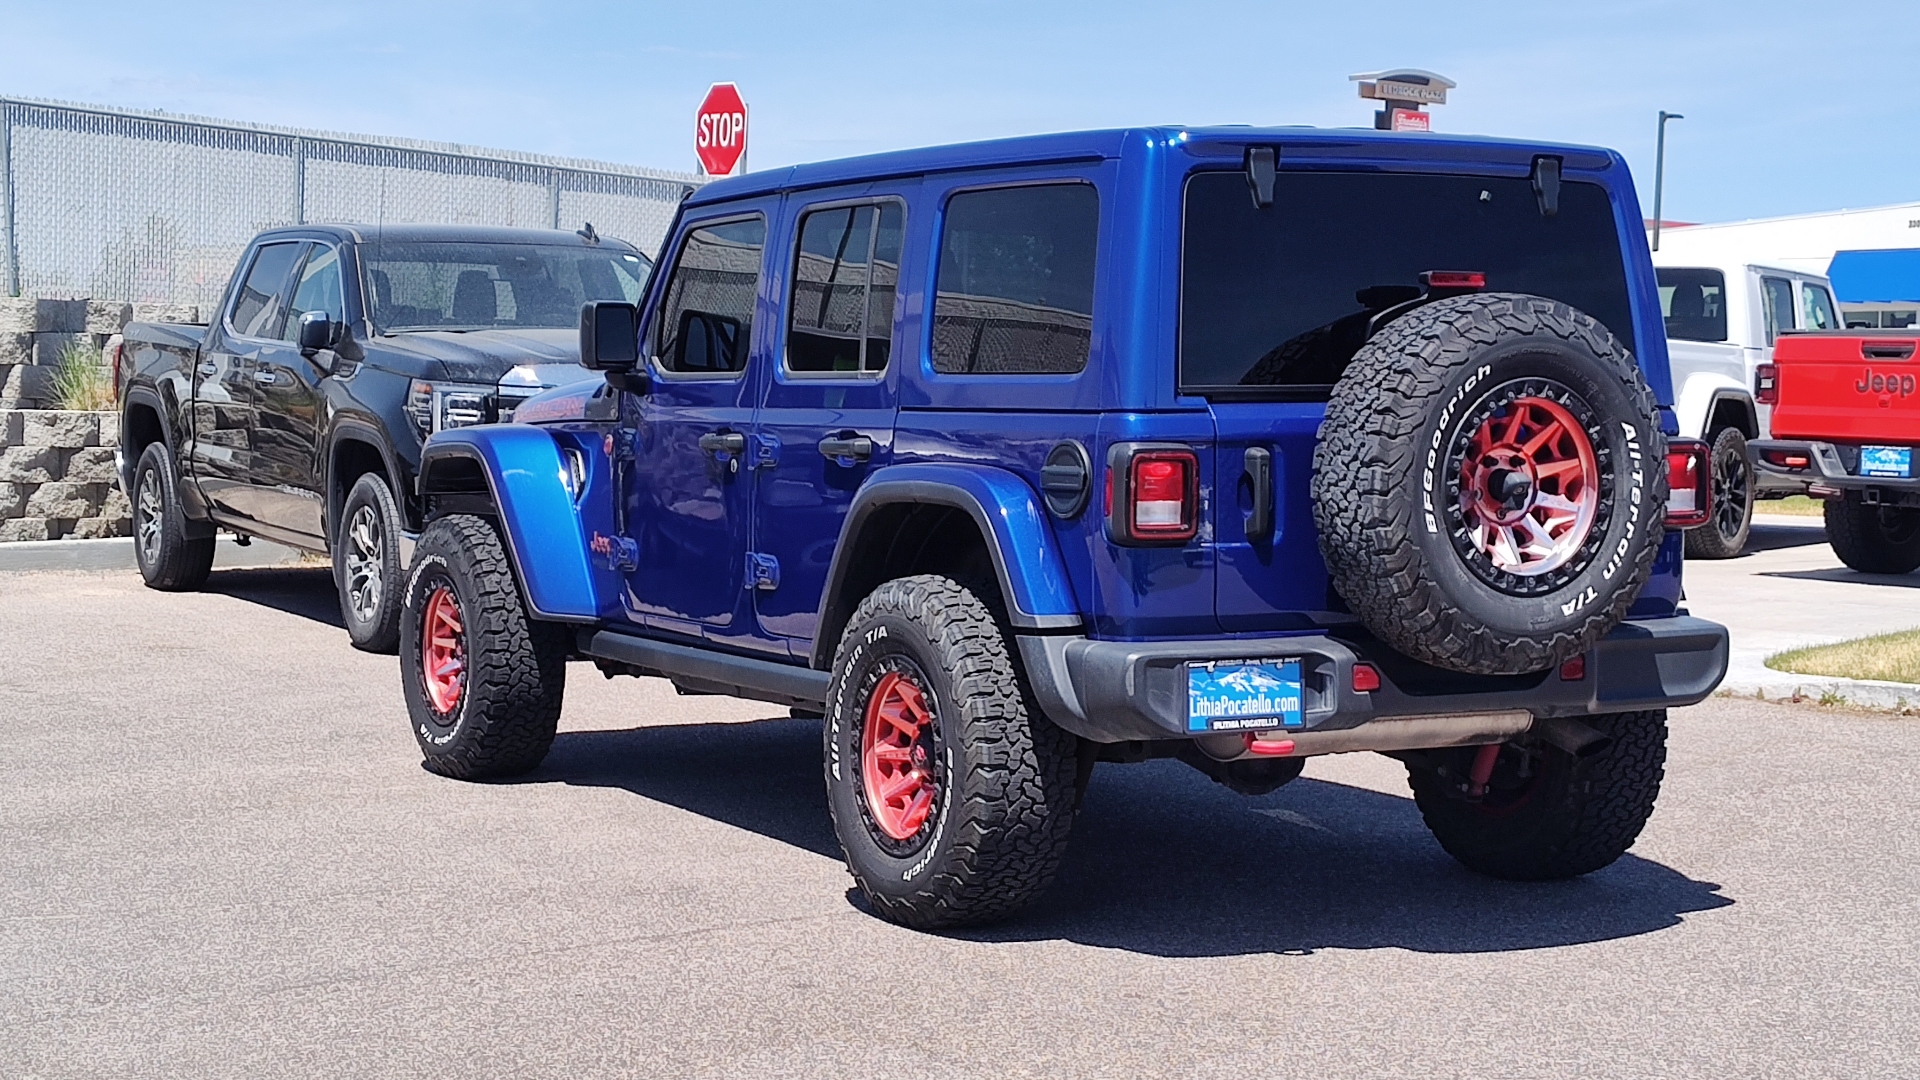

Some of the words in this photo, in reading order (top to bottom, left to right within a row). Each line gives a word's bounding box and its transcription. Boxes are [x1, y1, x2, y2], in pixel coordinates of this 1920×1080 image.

[698, 112, 743, 148] STOP
[1854, 367, 1916, 399] Jeep
[1422, 363, 1491, 534] BFGoodrich
[590, 531, 610, 558] Jeep
[405, 553, 448, 609] BFGoodrich
[1560, 585, 1599, 617] T/A
[864, 625, 888, 643] T/A
[1189, 693, 1299, 718] LithiaPocatello.com
[420, 723, 433, 743] T/A
[1240, 718, 1279, 728] POCATELLO
